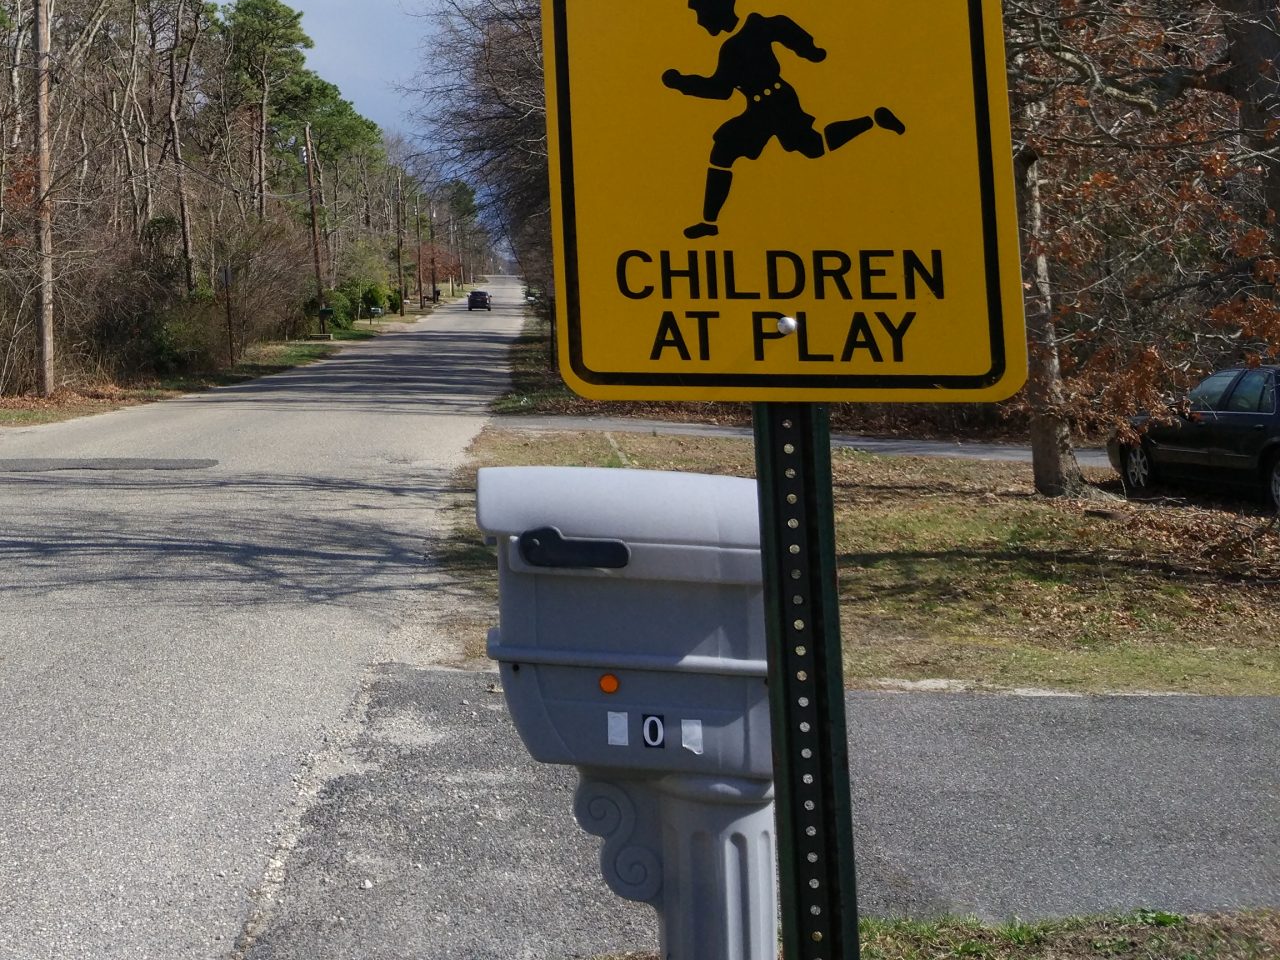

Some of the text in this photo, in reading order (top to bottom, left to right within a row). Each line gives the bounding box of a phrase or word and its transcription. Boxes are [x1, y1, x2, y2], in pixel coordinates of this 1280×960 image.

[616, 250, 945, 300] CHILDREN
[649, 311, 917, 362] AT PLAY
